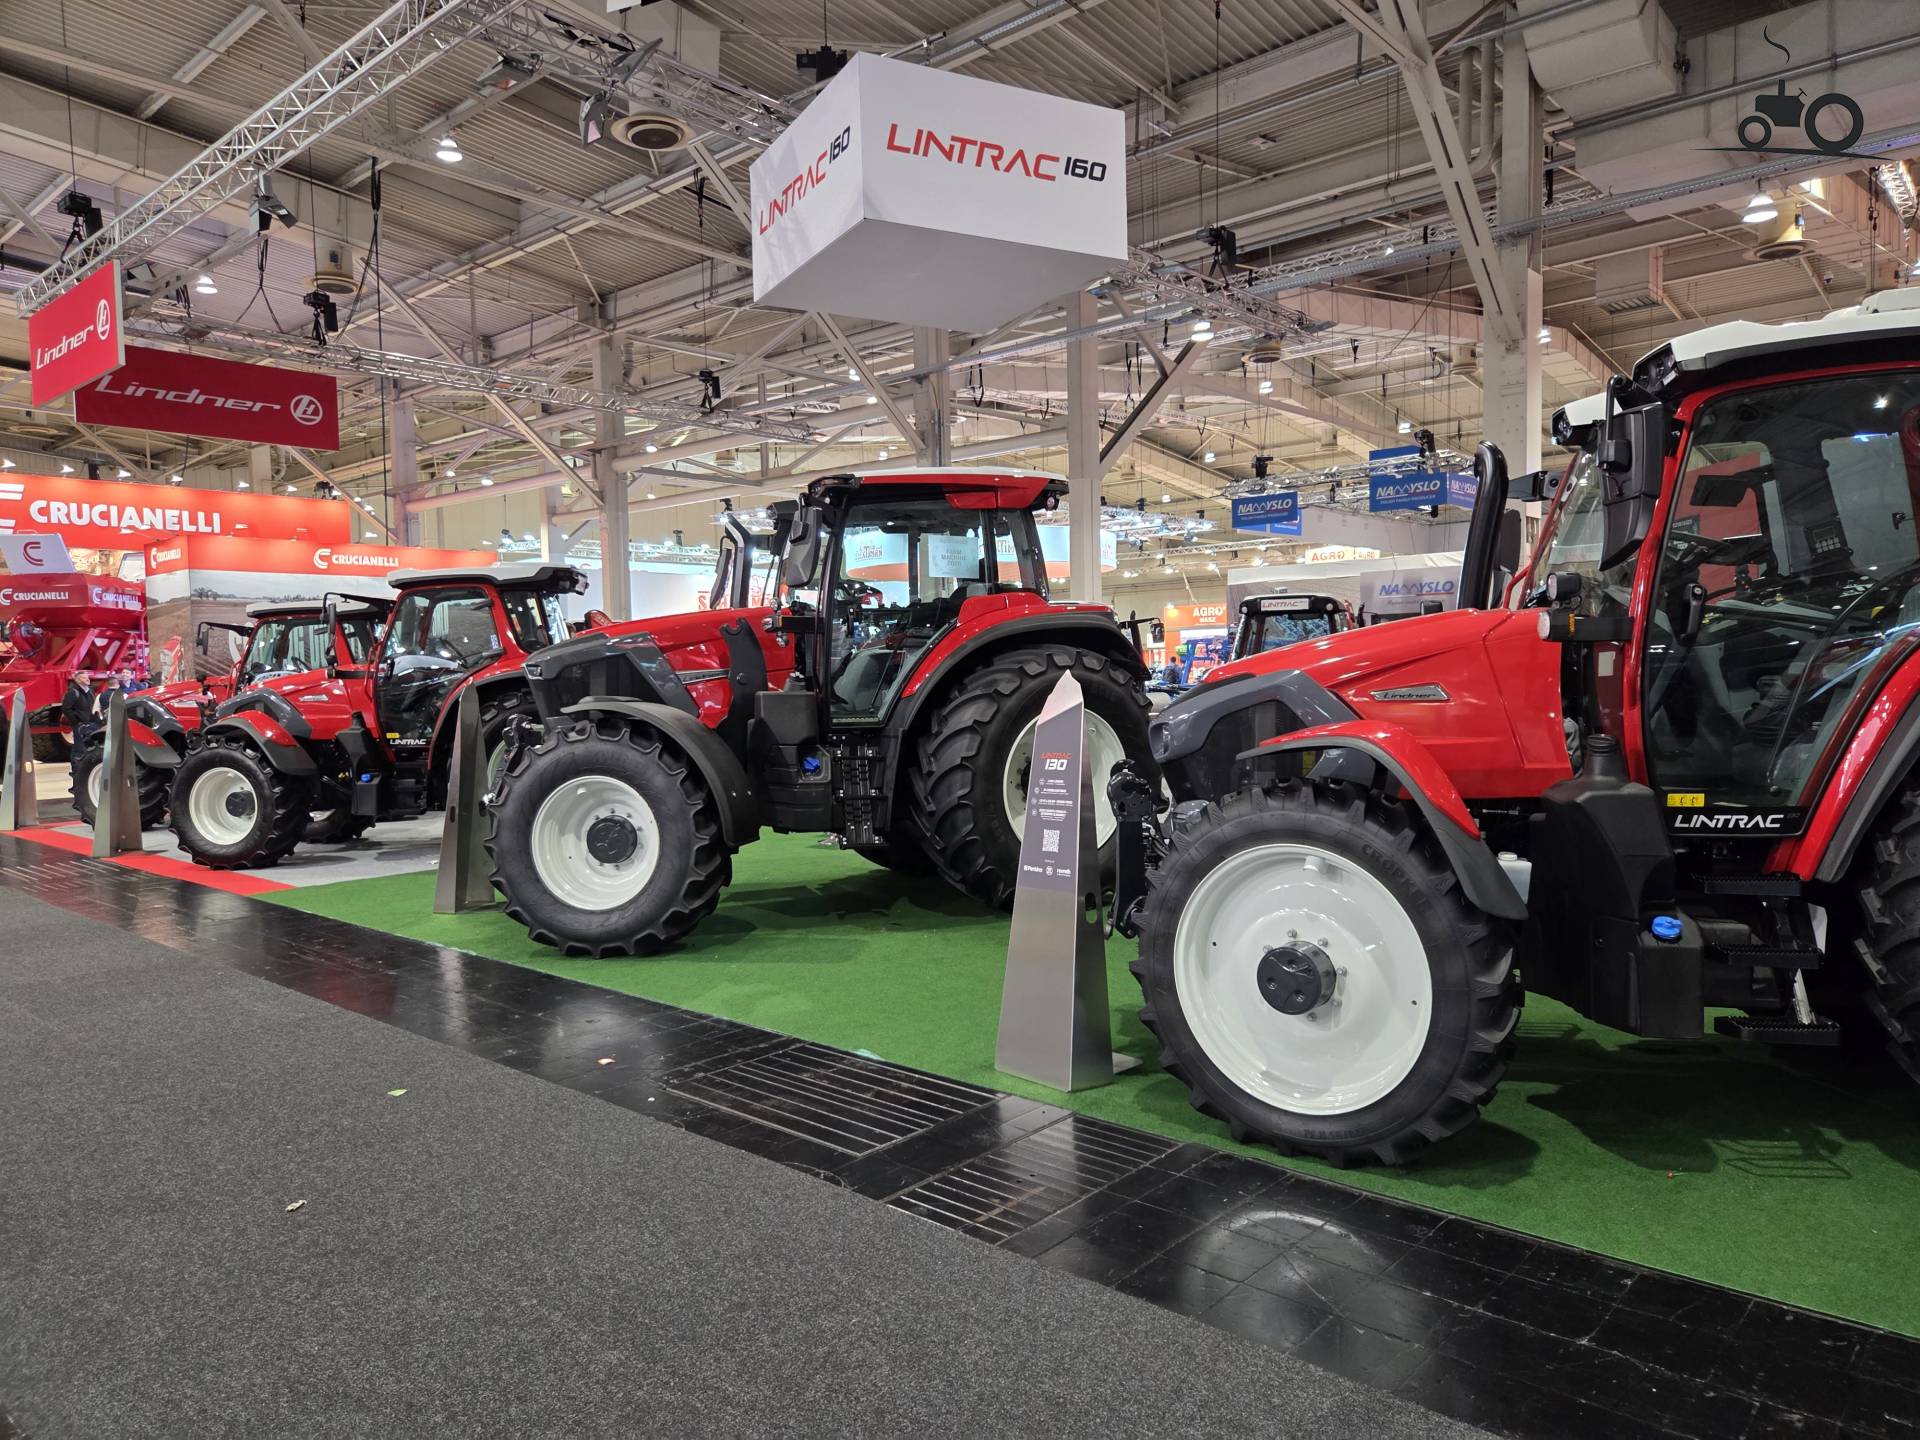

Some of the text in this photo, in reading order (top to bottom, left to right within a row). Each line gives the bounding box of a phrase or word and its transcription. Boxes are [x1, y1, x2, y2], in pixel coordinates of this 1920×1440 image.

[886, 123, 1108, 182] LINTRAC 160
[759, 124, 852, 236] LINTRAC 160
[36, 321, 94, 370] Lindner
[95, 373, 281, 412] Lindner
[29, 500, 221, 534] CRUCIANELLI
[331, 554, 399, 567] CRUCIANELLI
[1311, 551, 1345, 562] AGRO
[13, 591, 69, 601] CRUCIANELLI
[1192, 606, 1223, 617] AGRO
[1263, 601, 1299, 609] LINTRAC
[389, 738, 427, 746] LINTRAC
[1044, 759, 1068, 771] 130
[1674, 814, 1785, 829] LINTRAC
